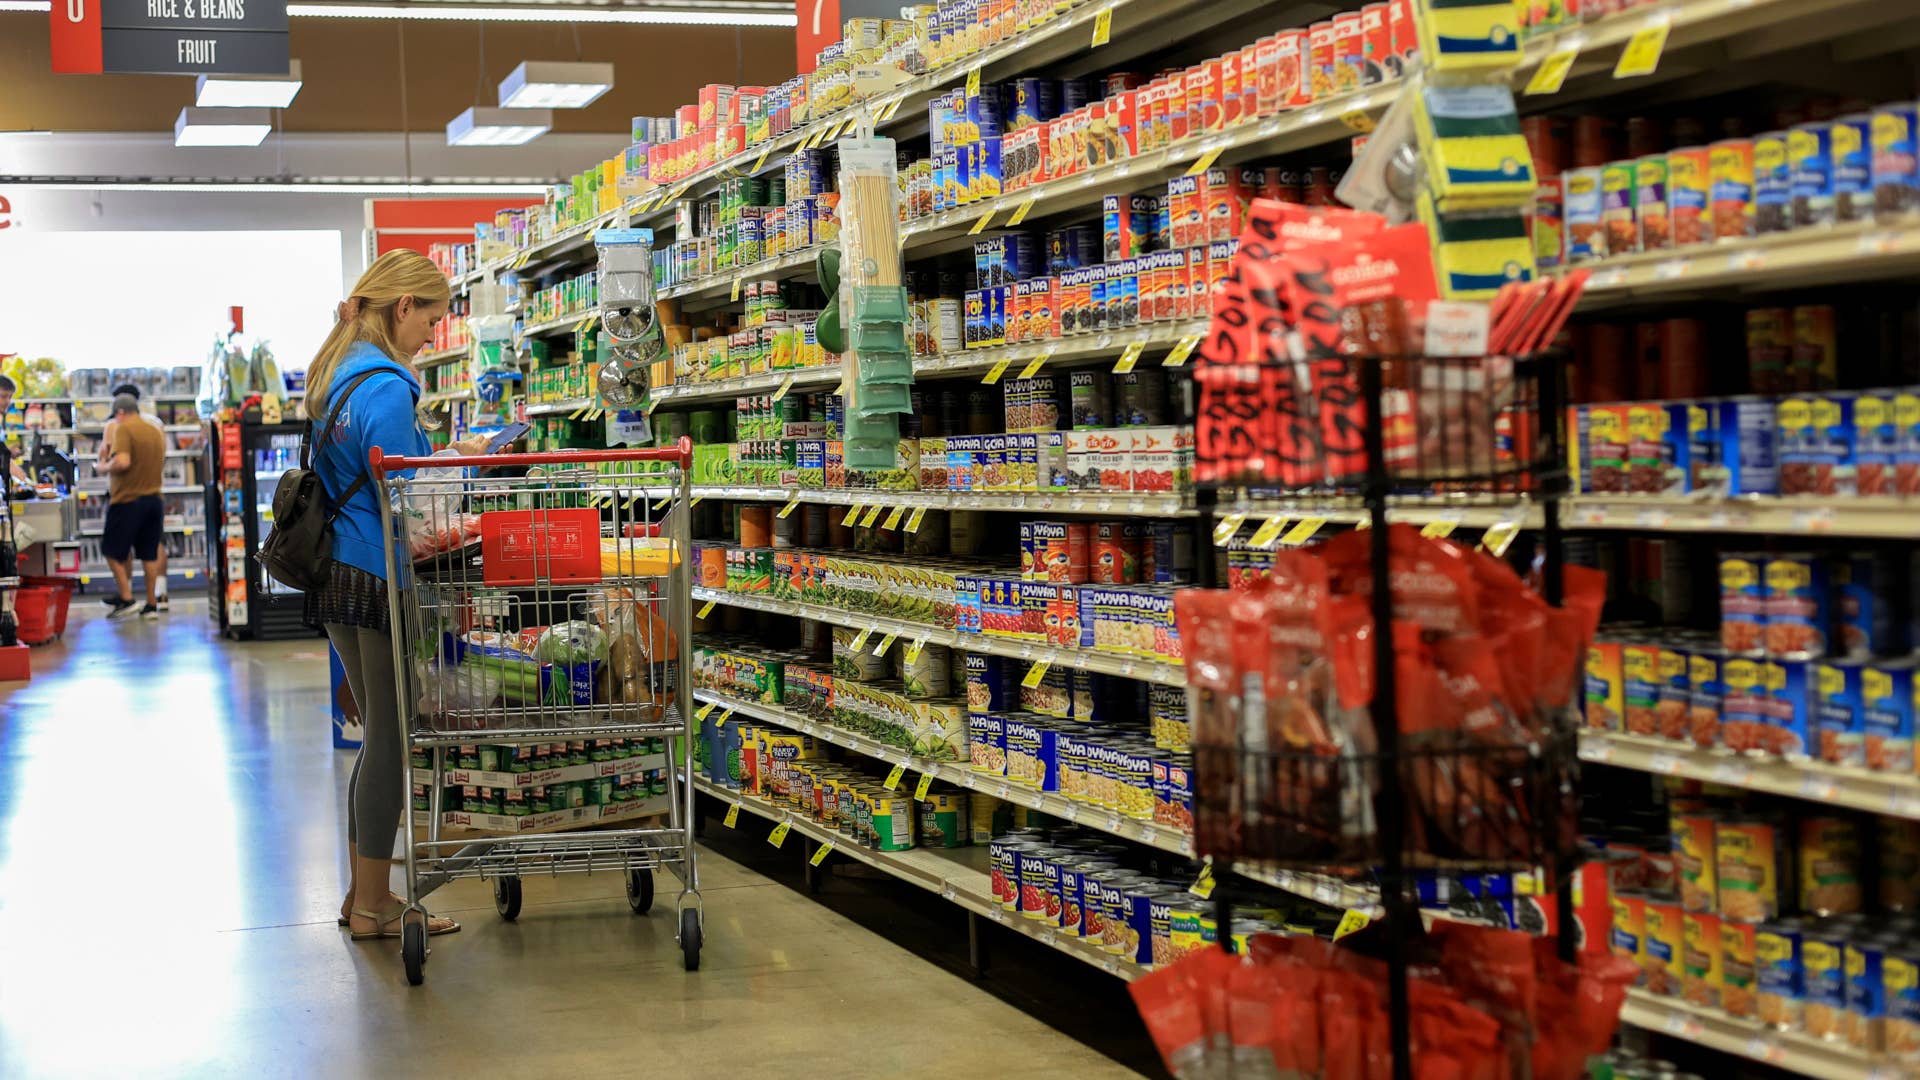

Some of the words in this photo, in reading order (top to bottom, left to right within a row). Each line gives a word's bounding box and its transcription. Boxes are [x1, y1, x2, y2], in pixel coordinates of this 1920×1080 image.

[148, 0, 179, 18] RICE
[184, 0, 196, 18] &
[201, 0, 244, 20] BEANS
[178, 39, 217, 64] FRUIT
[1208, 172, 1226, 185] YA
[1090, 266, 1104, 281] YA
[1121, 260, 1136, 275] YA
[1031, 379, 1053, 390] OYA
[1072, 374, 1093, 385] OYA
[1021, 436, 1035, 447] YA
[967, 657, 985, 668] OYA
[970, 716, 987, 728] OYA
[988, 720, 1001, 731] YA
[772, 760, 790, 770] BOIL
[1127, 760, 1150, 771] OYA
[1001, 852, 1013, 865] YA
[1022, 859, 1043, 872] OYA
[1044, 865, 1056, 878] YA
[1062, 873, 1075, 887] YA
[1084, 880, 1099, 894] YA
